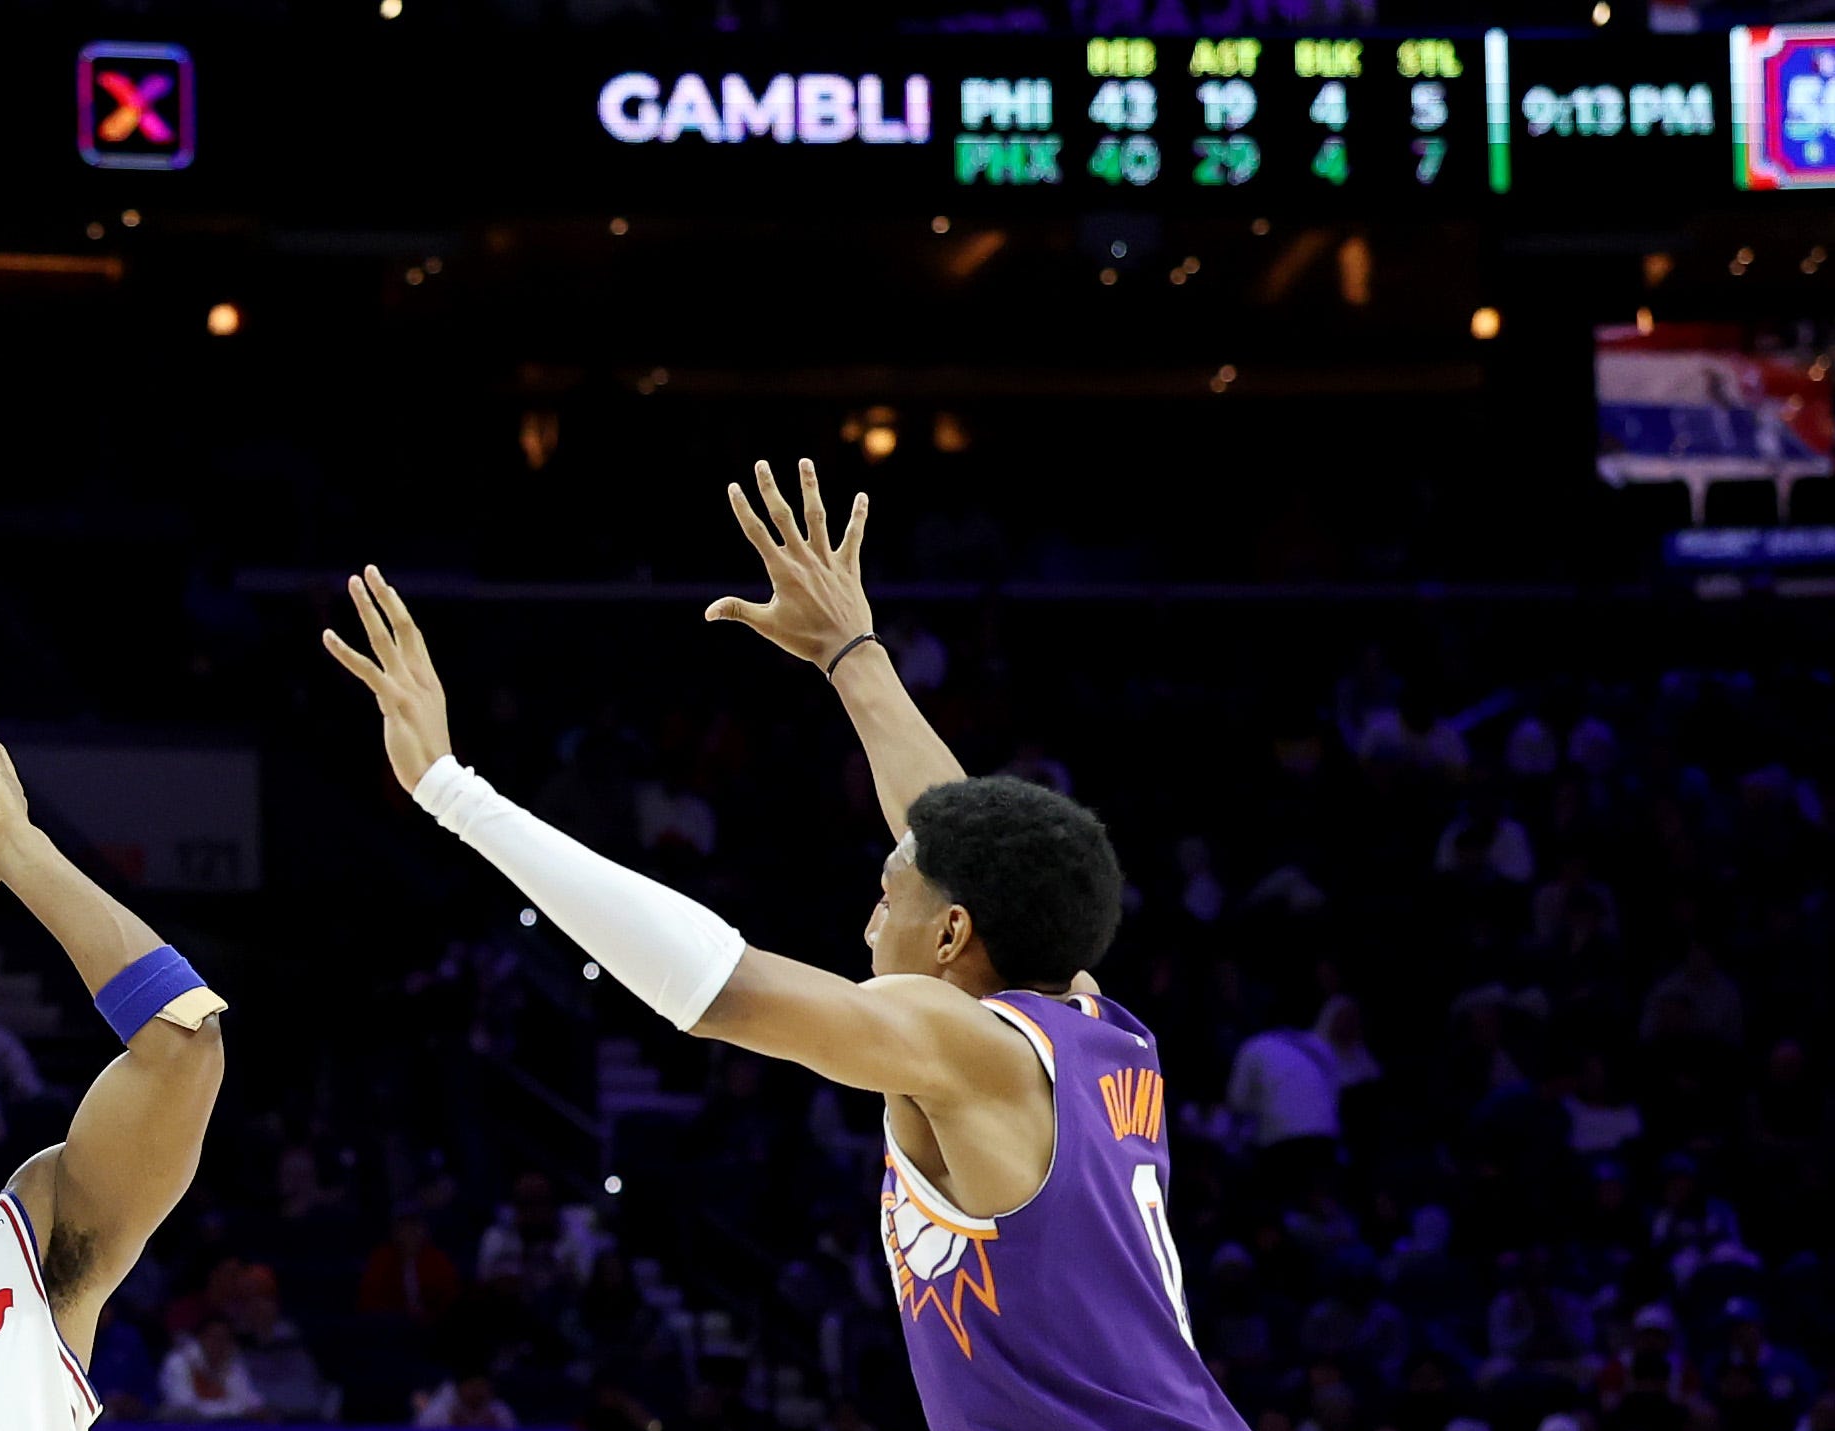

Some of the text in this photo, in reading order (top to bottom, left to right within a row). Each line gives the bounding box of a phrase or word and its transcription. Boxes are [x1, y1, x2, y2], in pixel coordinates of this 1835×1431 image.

[598, 72, 932, 143] GAMBLI
[961, 77, 1448, 132] PHI 43 19 4 5
[1630, 83, 1714, 136] PM
[954, 133, 1447, 186] PHX 40 29 4 7
